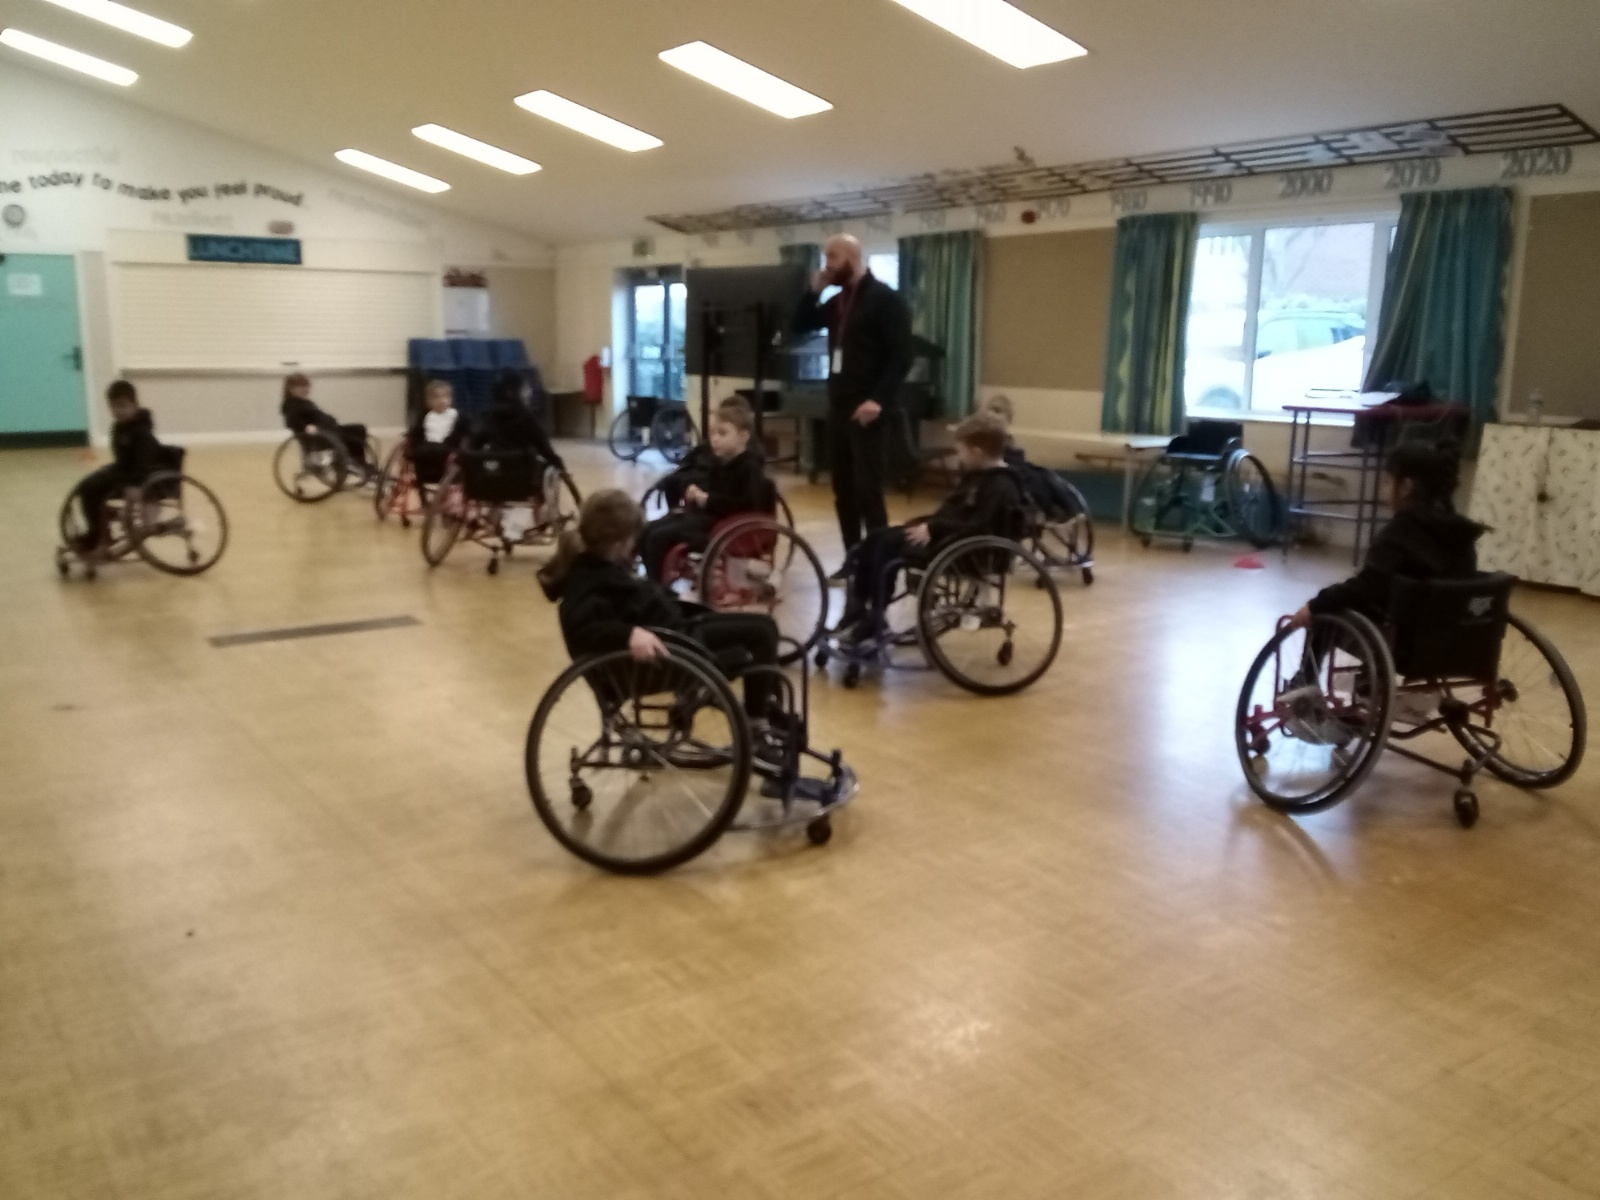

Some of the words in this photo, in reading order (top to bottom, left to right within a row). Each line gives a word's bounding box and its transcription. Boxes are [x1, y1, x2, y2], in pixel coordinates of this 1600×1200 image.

[28, 169, 83, 188] today
[92, 172, 113, 191] to
[117, 182, 171, 200] make
[1279, 168, 1335, 200] 2000
[1384, 156, 1442, 190] 2010
[1501, 146, 1573, 179] 2020
